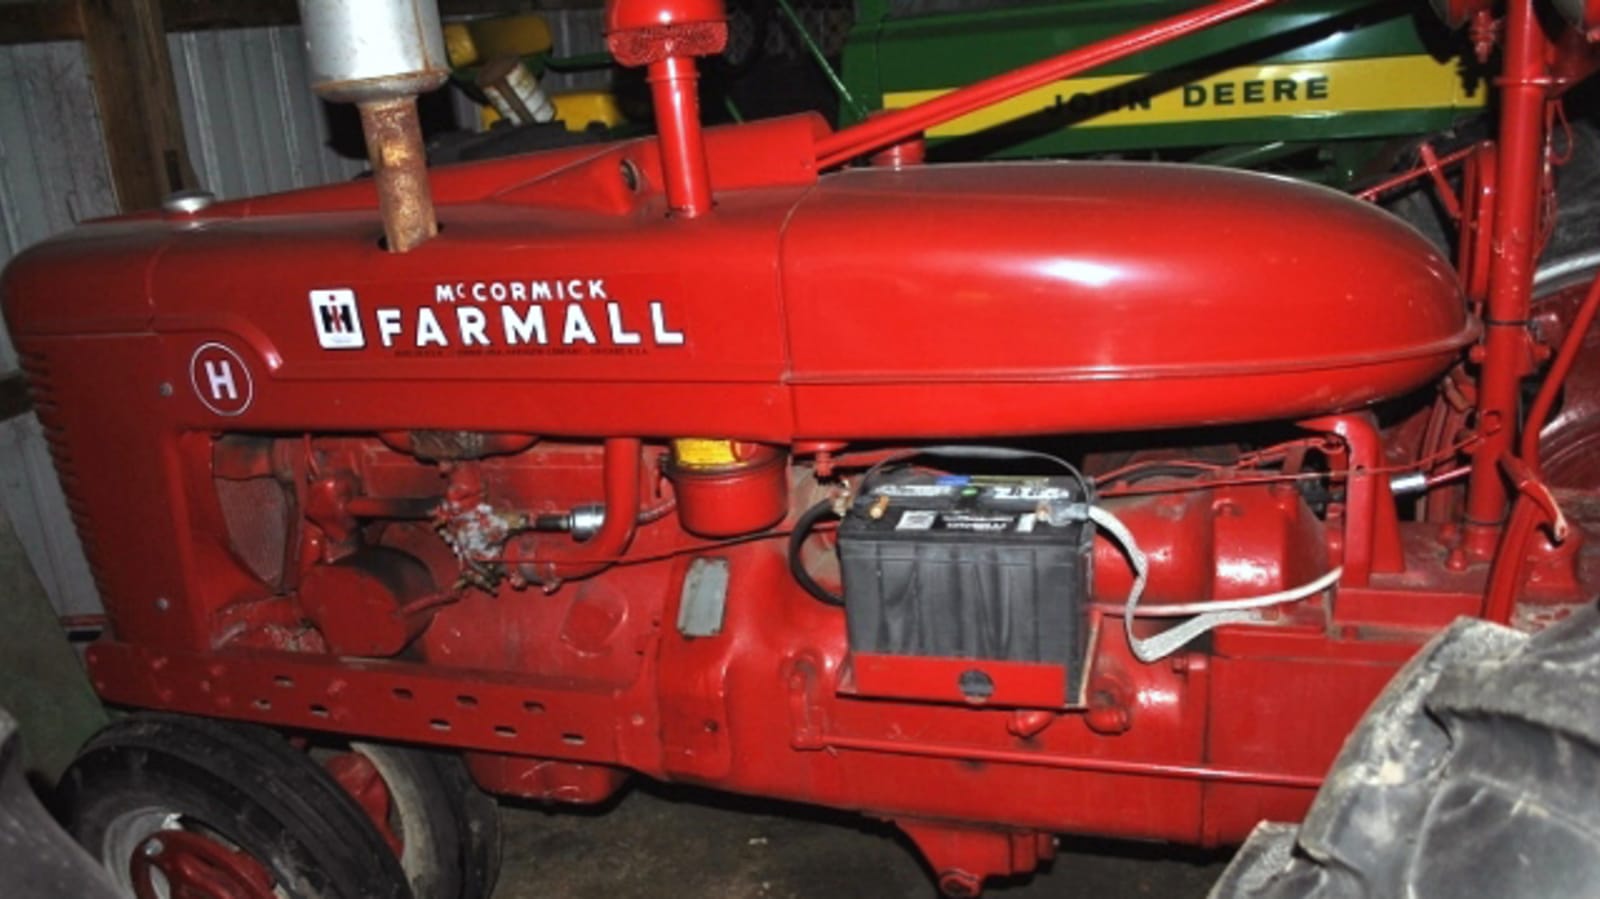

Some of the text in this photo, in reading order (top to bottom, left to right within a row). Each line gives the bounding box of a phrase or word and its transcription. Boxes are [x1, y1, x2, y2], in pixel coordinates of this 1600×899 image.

[1047, 77, 1329, 112] JON DEERE
[377, 301, 684, 347] FARMALL
[204, 360, 238, 399] H
